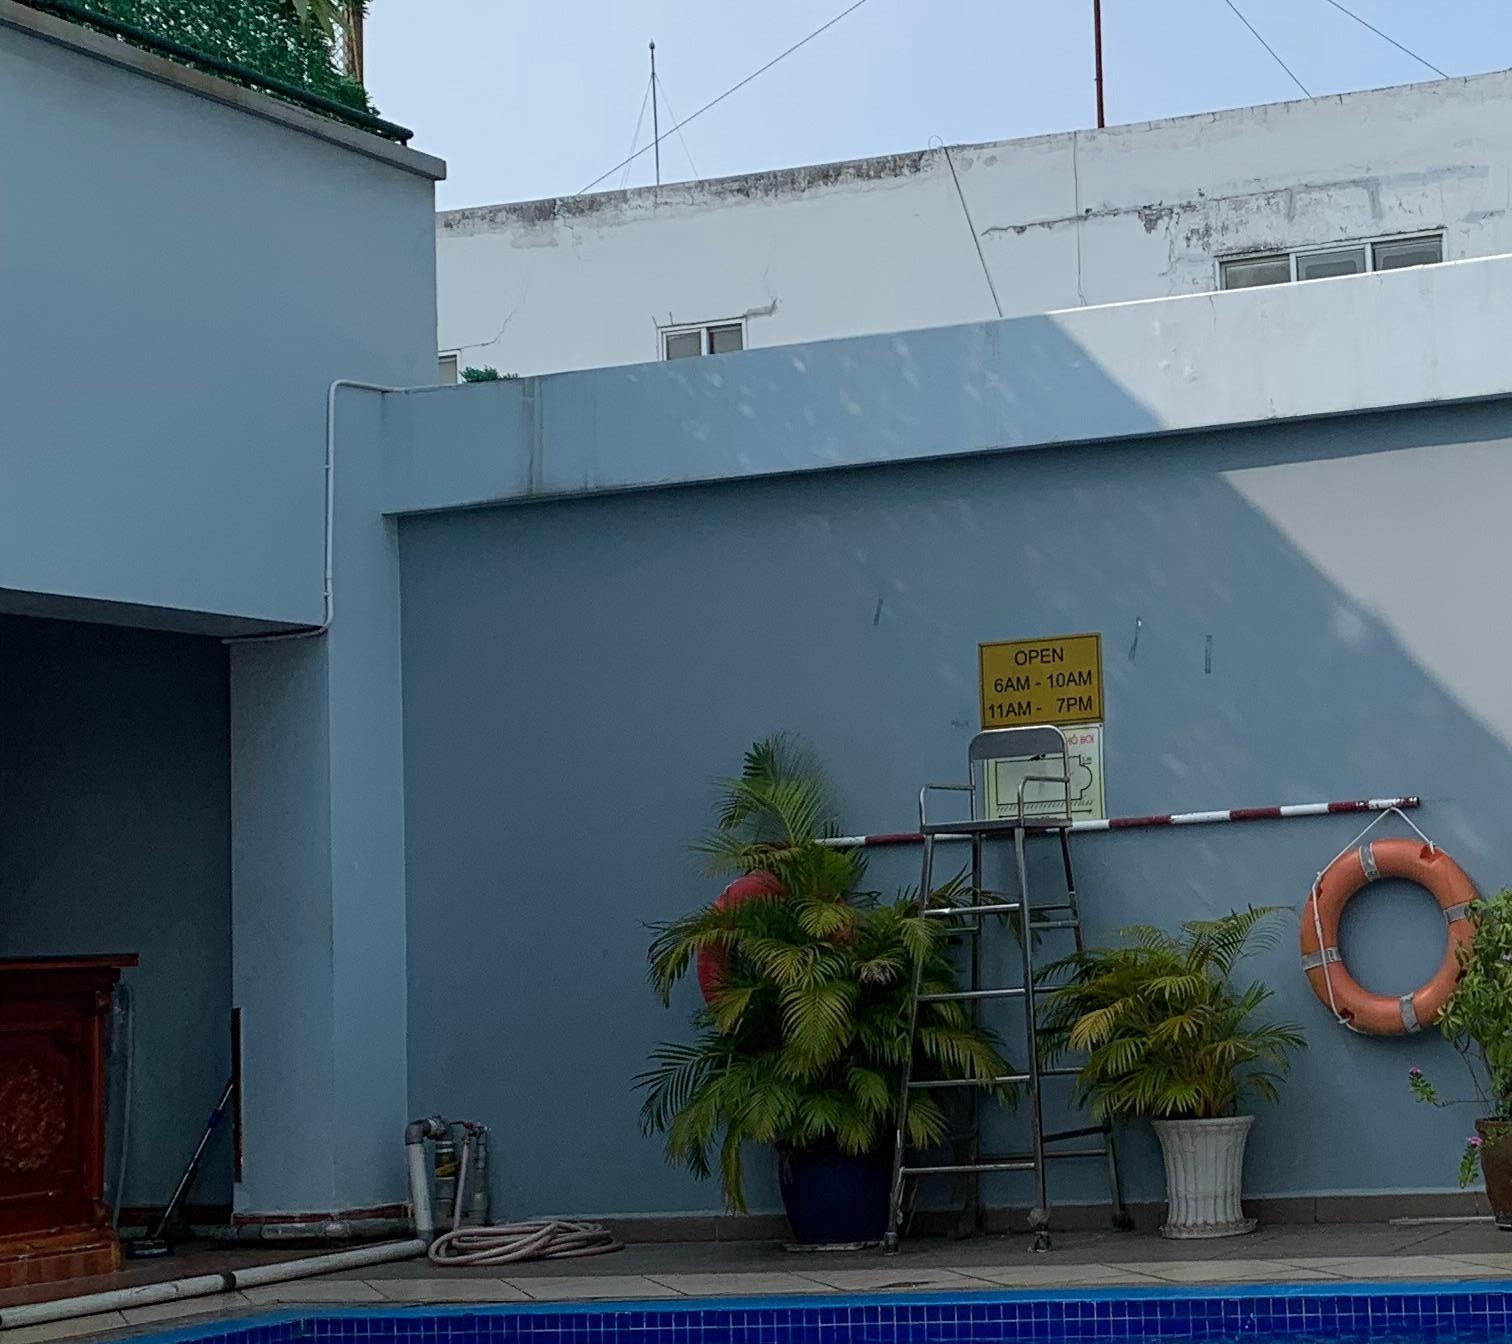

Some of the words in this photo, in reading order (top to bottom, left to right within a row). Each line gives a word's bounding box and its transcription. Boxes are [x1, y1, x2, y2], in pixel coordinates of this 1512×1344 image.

[1014, 647, 1064, 666] OPEN
[994, 675, 1031, 693] 6AM
[1046, 669, 1092, 688] 10AM
[988, 701, 1032, 719] 11AM
[1056, 695, 1093, 713] 7PM
